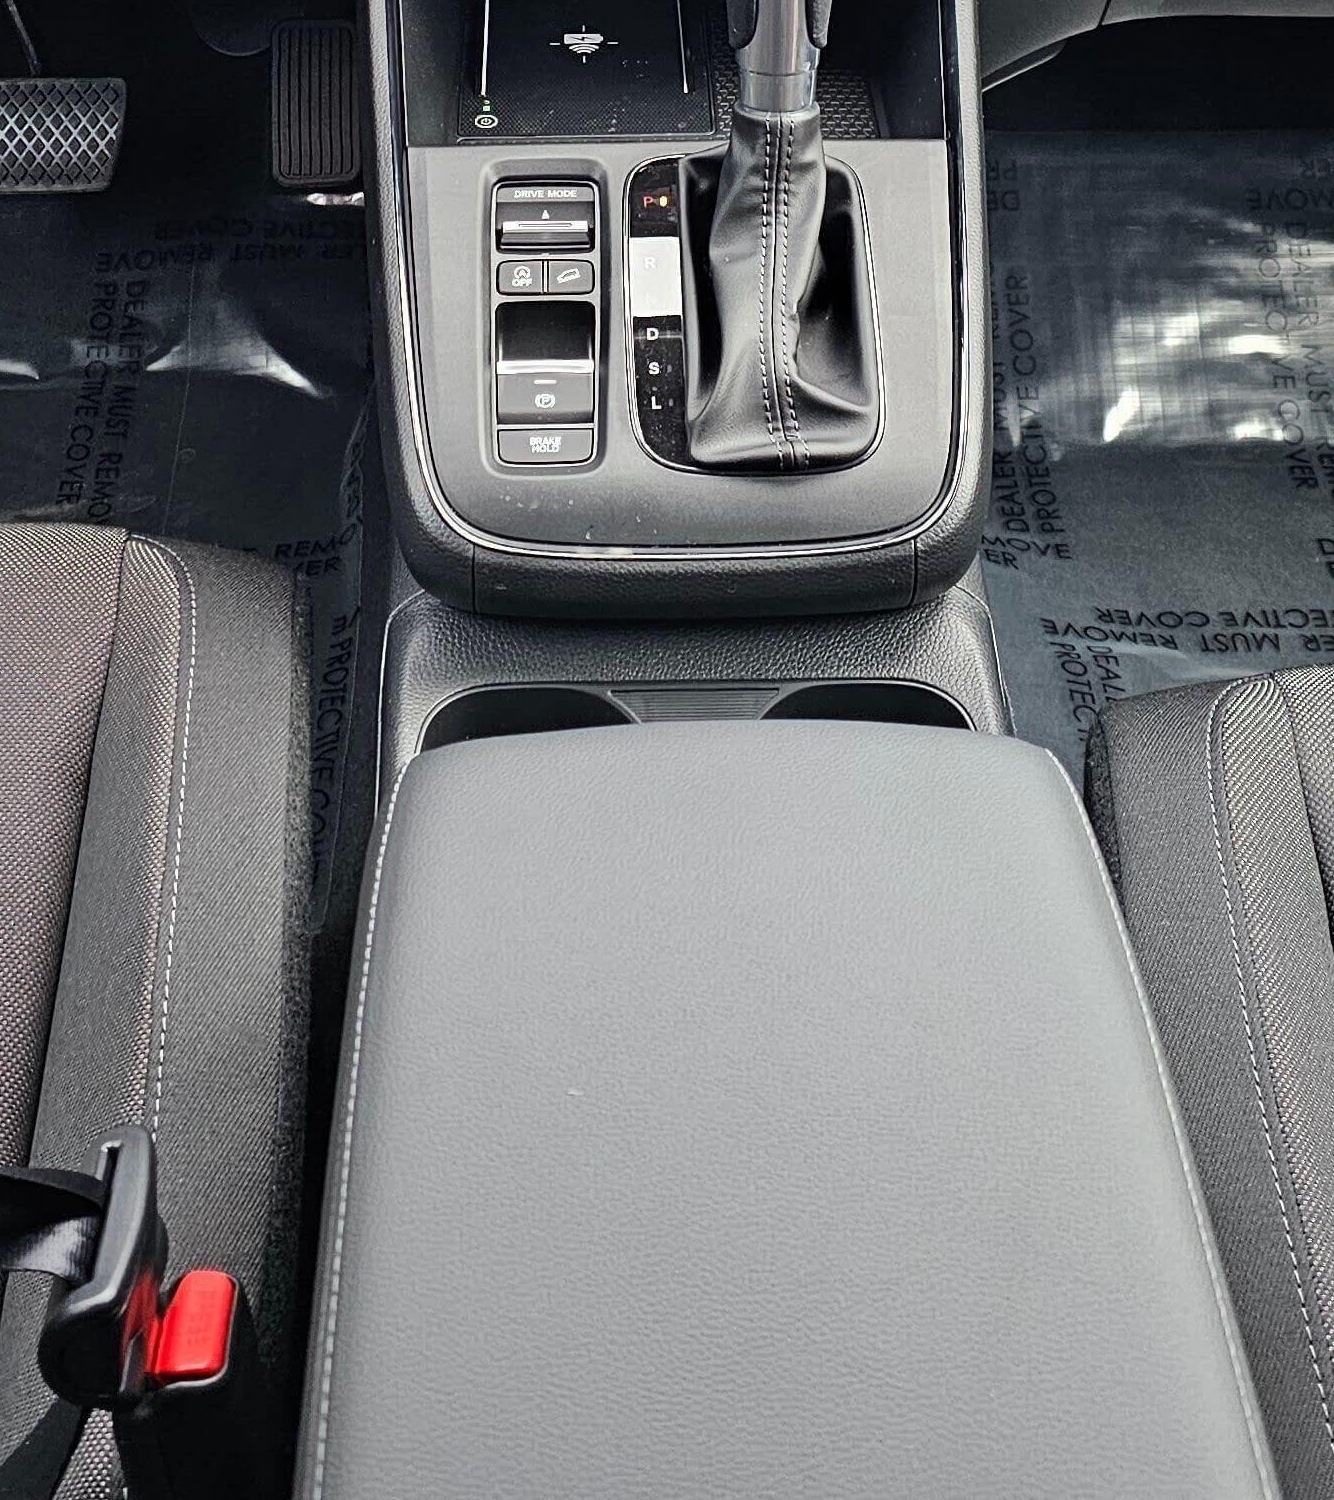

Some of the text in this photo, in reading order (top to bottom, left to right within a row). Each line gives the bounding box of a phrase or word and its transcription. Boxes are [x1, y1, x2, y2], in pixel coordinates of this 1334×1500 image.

[514, 189, 578, 198] DRIVE MODE
[642, 195, 656, 208] P
[511, 277, 532, 287] OFF
[117, 280, 147, 374] DEALER
[646, 327, 659, 340] D
[649, 362, 660, 375] S
[57, 281, 117, 506] PROTECTIVE COVER
[652, 396, 662, 409] L
[529, 437, 562, 447] BRAKE
[531, 444, 560, 453] HOLD
[1092, 604, 1213, 630] COVER
[1037, 616, 1179, 651] REMOVE
[1201, 631, 1280, 652] MUST
